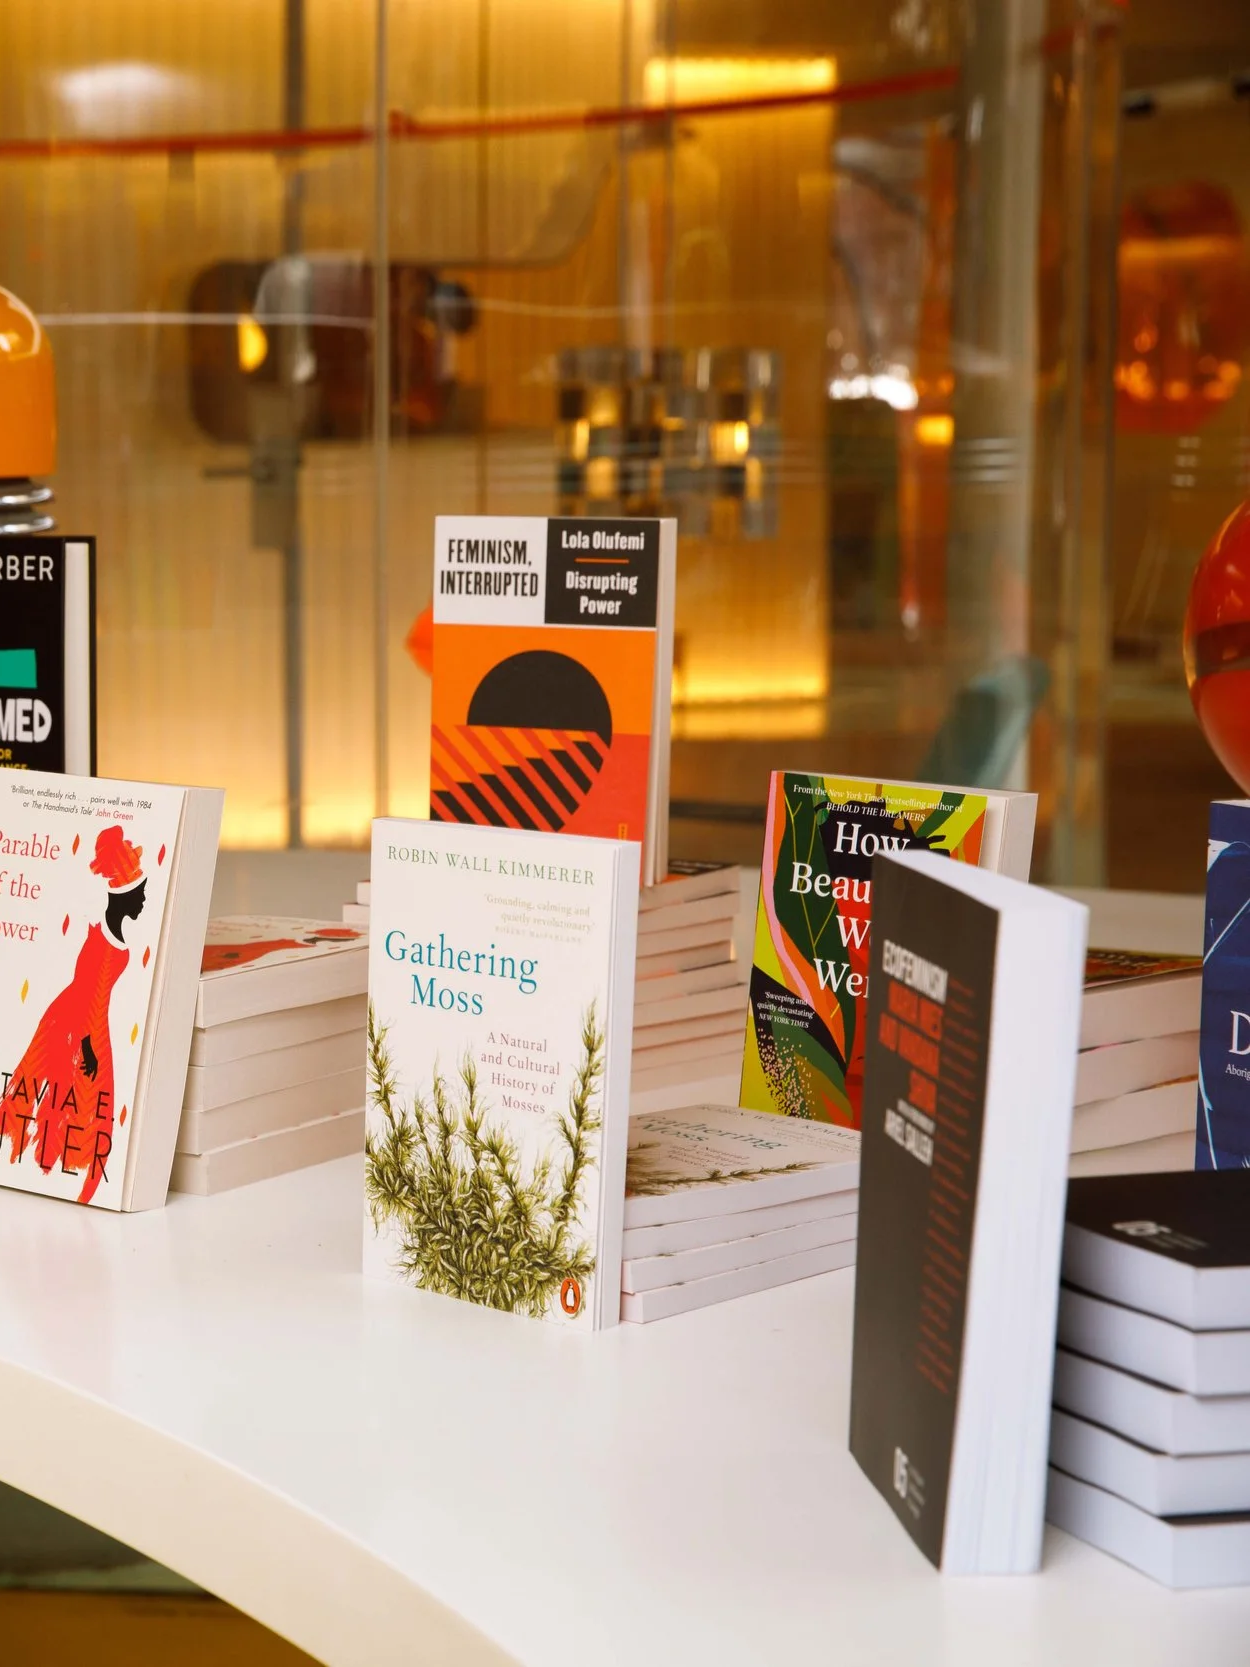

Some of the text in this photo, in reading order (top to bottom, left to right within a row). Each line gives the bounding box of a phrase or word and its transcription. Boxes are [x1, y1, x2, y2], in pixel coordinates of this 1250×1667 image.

[561, 530, 645, 550] Lola Olufemi
[448, 539, 532, 567] FEMINISM,
[440, 570, 538, 597] INTERRUPTED
[565, 571, 638, 595] Disrupting
[579, 596, 622, 615] Power
[36, 787, 63, 800] endlessly
[65, 790, 76, 800] rich
[90, 795, 105, 804] pairs
[108, 796, 119, 806] well
[121, 798, 134, 807] with
[136, 800, 152, 809] 1984
[793, 784, 963, 813] From the New York Times bestselling author of
[31, 800, 42, 809] The
[43, 803, 79, 814] Handmaid's
[95, 809, 111, 818] John
[113, 811, 134, 821] Green
[826, 802, 926, 822] BEHOLD THE DREAMERS
[833, 821, 910, 857] How
[388, 846, 595, 885] ROBIN WALL KIMMERER
[10, 873, 41, 900] the
[501, 912, 530, 926] quietly
[536, 901, 571, 917] calming
[574, 906, 590, 917] and
[836, 915, 872, 950] W
[385, 930, 538, 994] Gathering
[410, 974, 484, 1015] Moss
[795, 998, 808, 1006] and
[756, 1002, 778, 1012] quietly
[759, 1013, 810, 1029] NEW YORK TIMES
[487, 1031, 547, 1052] A Natural
[481, 1052, 560, 1075] and Cultural
[491, 1072, 556, 1096] History of
[96, 1090, 115, 1122] E.
[502, 1094, 546, 1114] Mosses
[637, 1116, 788, 1150] Gathering
